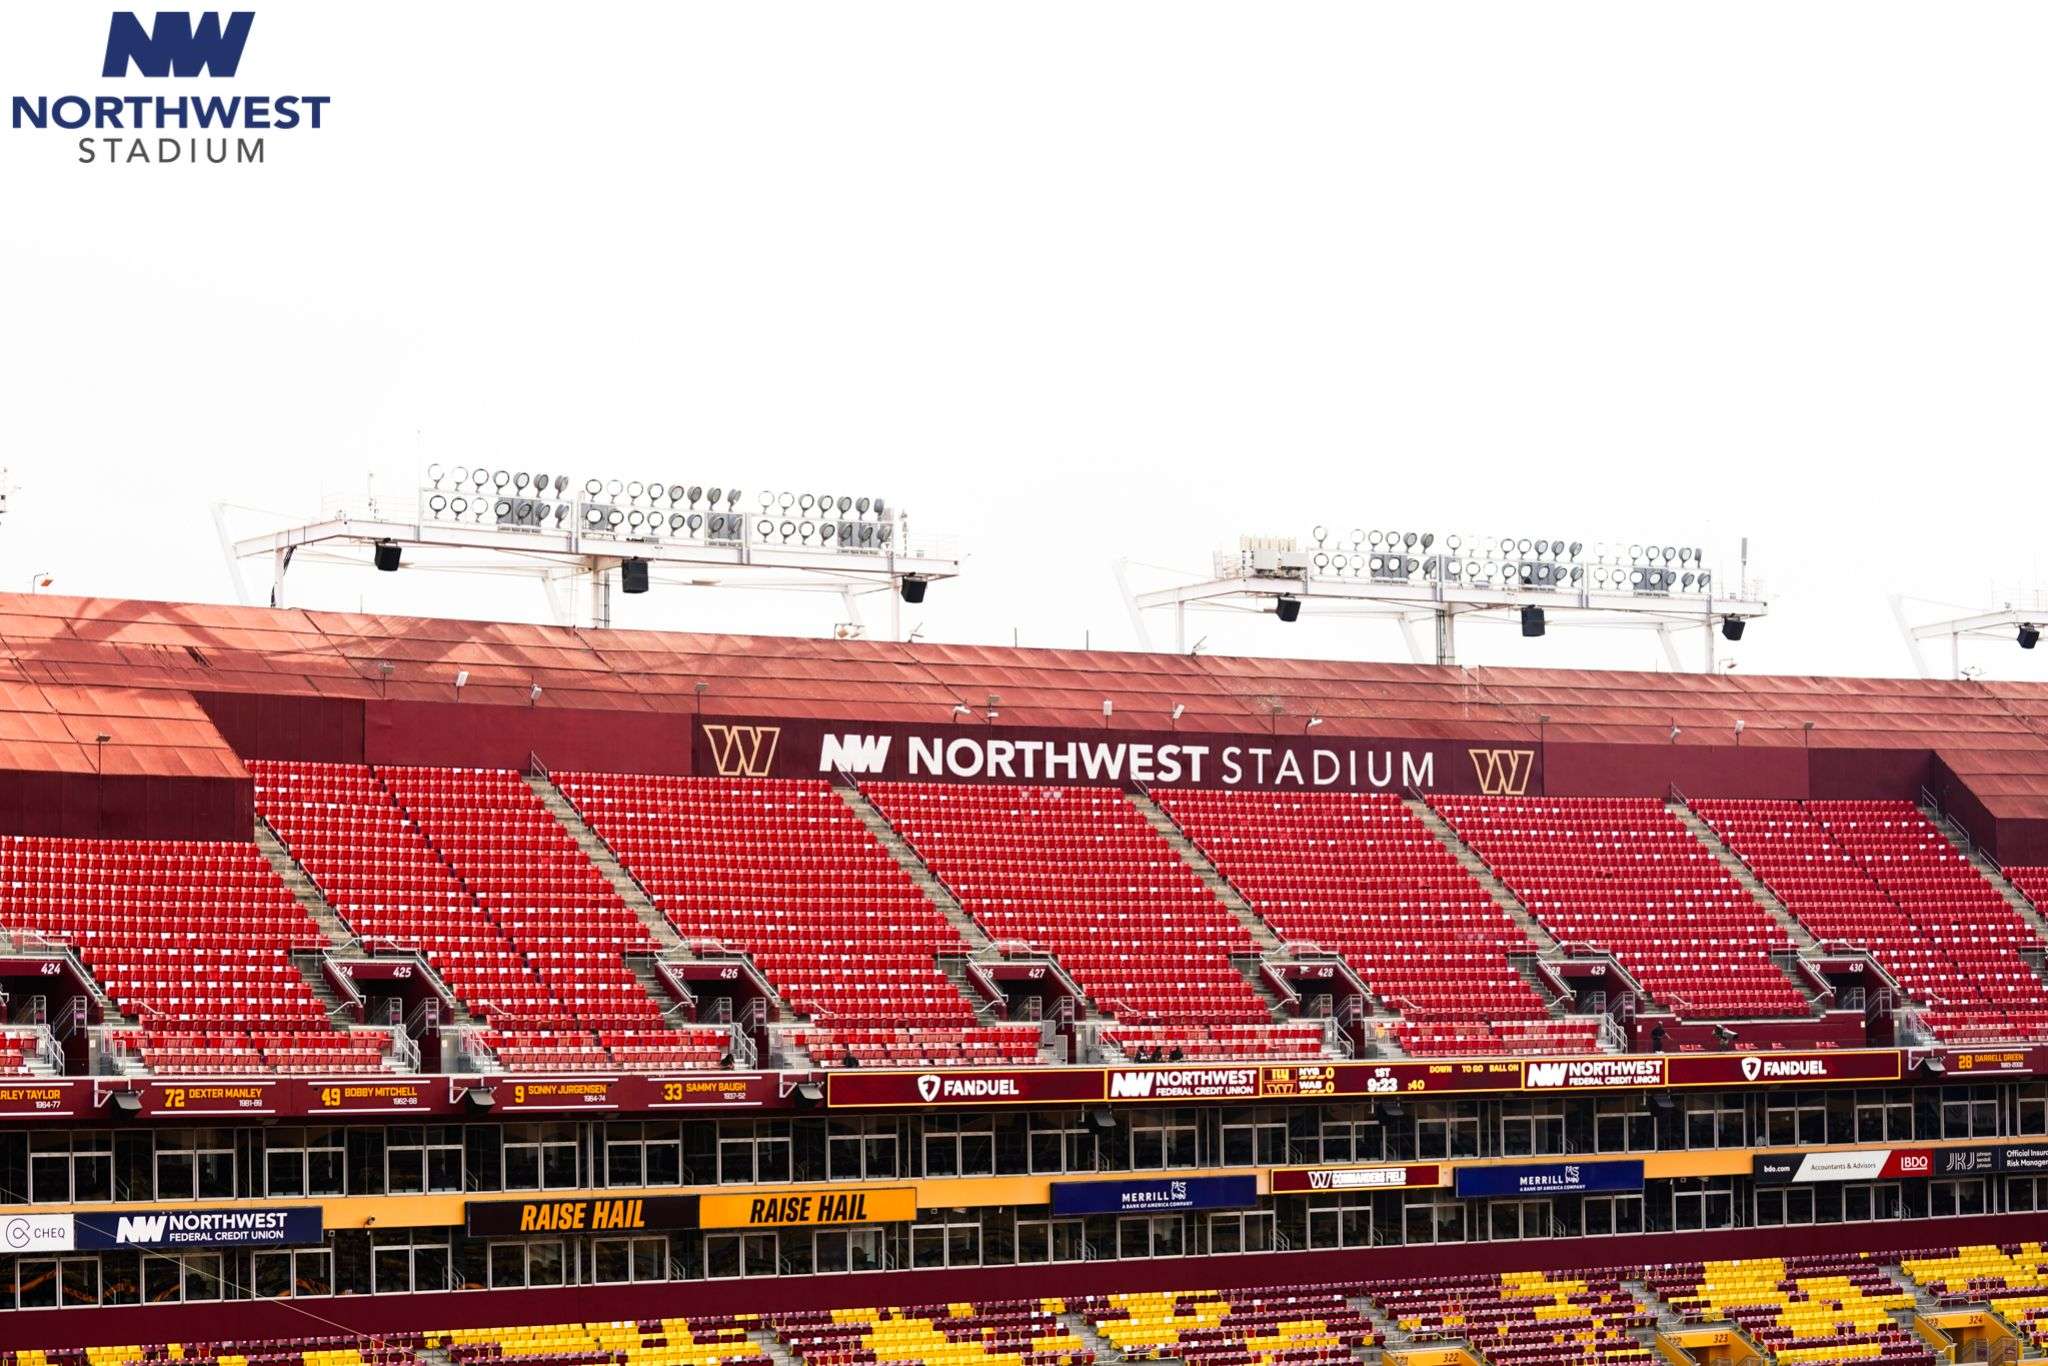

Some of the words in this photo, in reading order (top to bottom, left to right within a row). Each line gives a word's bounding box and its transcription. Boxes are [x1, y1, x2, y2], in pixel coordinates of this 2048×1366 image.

[908, 737, 1209, 783] NORTHWEST
[1222, 746, 1433, 787] STADIUM
[41, 962, 60, 975] 424
[393, 966, 412, 978] 425
[720, 968, 738, 979] 426
[1028, 968, 1046, 978] 427
[1317, 967, 1333, 978] 428
[1590, 966, 1606, 976] 429
[1849, 963, 1864, 972] 430
[1958, 1055, 1973, 1069] 28
[1974, 1054, 2003, 1063] DARRELL
[2002, 1052, 2024, 1062] GREEN
[1325, 1066, 1335, 1080] 0
[1374, 1067, 1391, 1078] 1ST
[1429, 1065, 1453, 1074] DOWN
[1461, 1064, 1472, 1073] TO
[1472, 1064, 1484, 1073] GO
[1489, 1063, 1508, 1073] BALL
[1507, 1062, 1519, 1072] ON
[1568, 1060, 1663, 1077] NORTHWEST
[1763, 1060, 1827, 1076] FANDUEL
[1155, 1070, 1257, 1087] NORTHWEST
[1367, 1077, 1398, 1092] 9:23
[1568, 1076, 1604, 1086] FEDERAL
[1604, 1075, 1633, 1085] CREDIT
[1633, 1074, 1661, 1084] UNION
[663, 1083, 683, 1102] 33
[685, 1082, 718, 1092] SAMMY
[718, 1081, 746, 1092] BAUGH
[943, 1079, 1020, 1097] FANDUEL
[1155, 1087, 1193, 1097] FEDERAL
[1194, 1085, 1224, 1096] CREDIT
[1225, 1085, 1254, 1095] UNION
[1325, 1080, 1335, 1094] 0
[26, 1089, 61, 1100] TAYLOR
[165, 1088, 185, 1108] 72
[188, 1088, 224, 1099] DEXTER
[225, 1088, 263, 1098] MANLEY
[321, 1087, 341, 1107] 49
[344, 1087, 374, 1098] BOBBY
[374, 1086, 418, 1097] MITCHELL
[514, 1085, 525, 1104] 9
[528, 1084, 558, 1095] SONNY
[558, 1083, 608, 1094] JURGENSEN
[2006, 1149, 2030, 1158] Official
[1811, 1163, 1846, 1171] Accountants
[1852, 1161, 1876, 1169] Advisors
[1904, 1156, 1928, 1168] BDO
[1945, 1151, 1975, 1171] JKJ
[2006, 1159, 2019, 1167] Risk
[1763, 1165, 1791, 1173] bdo.com
[1519, 1175, 1564, 1186] MERRILL
[1122, 1191, 1170, 1203] MERRILL
[750, 1196, 811, 1224] RAISE
[816, 1193, 868, 1222] HAIL
[520, 1202, 586, 1231] RAISE
[593, 1199, 645, 1228] HAIL
[169, 1212, 288, 1231] NORTHWEST
[34, 1227, 66, 1239] CHEQ
[169, 1232, 213, 1242] FEDERAL
[214, 1231, 251, 1241] CREDIT
[251, 1230, 285, 1239] UNION
[1968, 1315, 1983, 1325] 324
[1713, 1333, 1729, 1343] 323
[1443, 1352, 1459, 1363] 322
